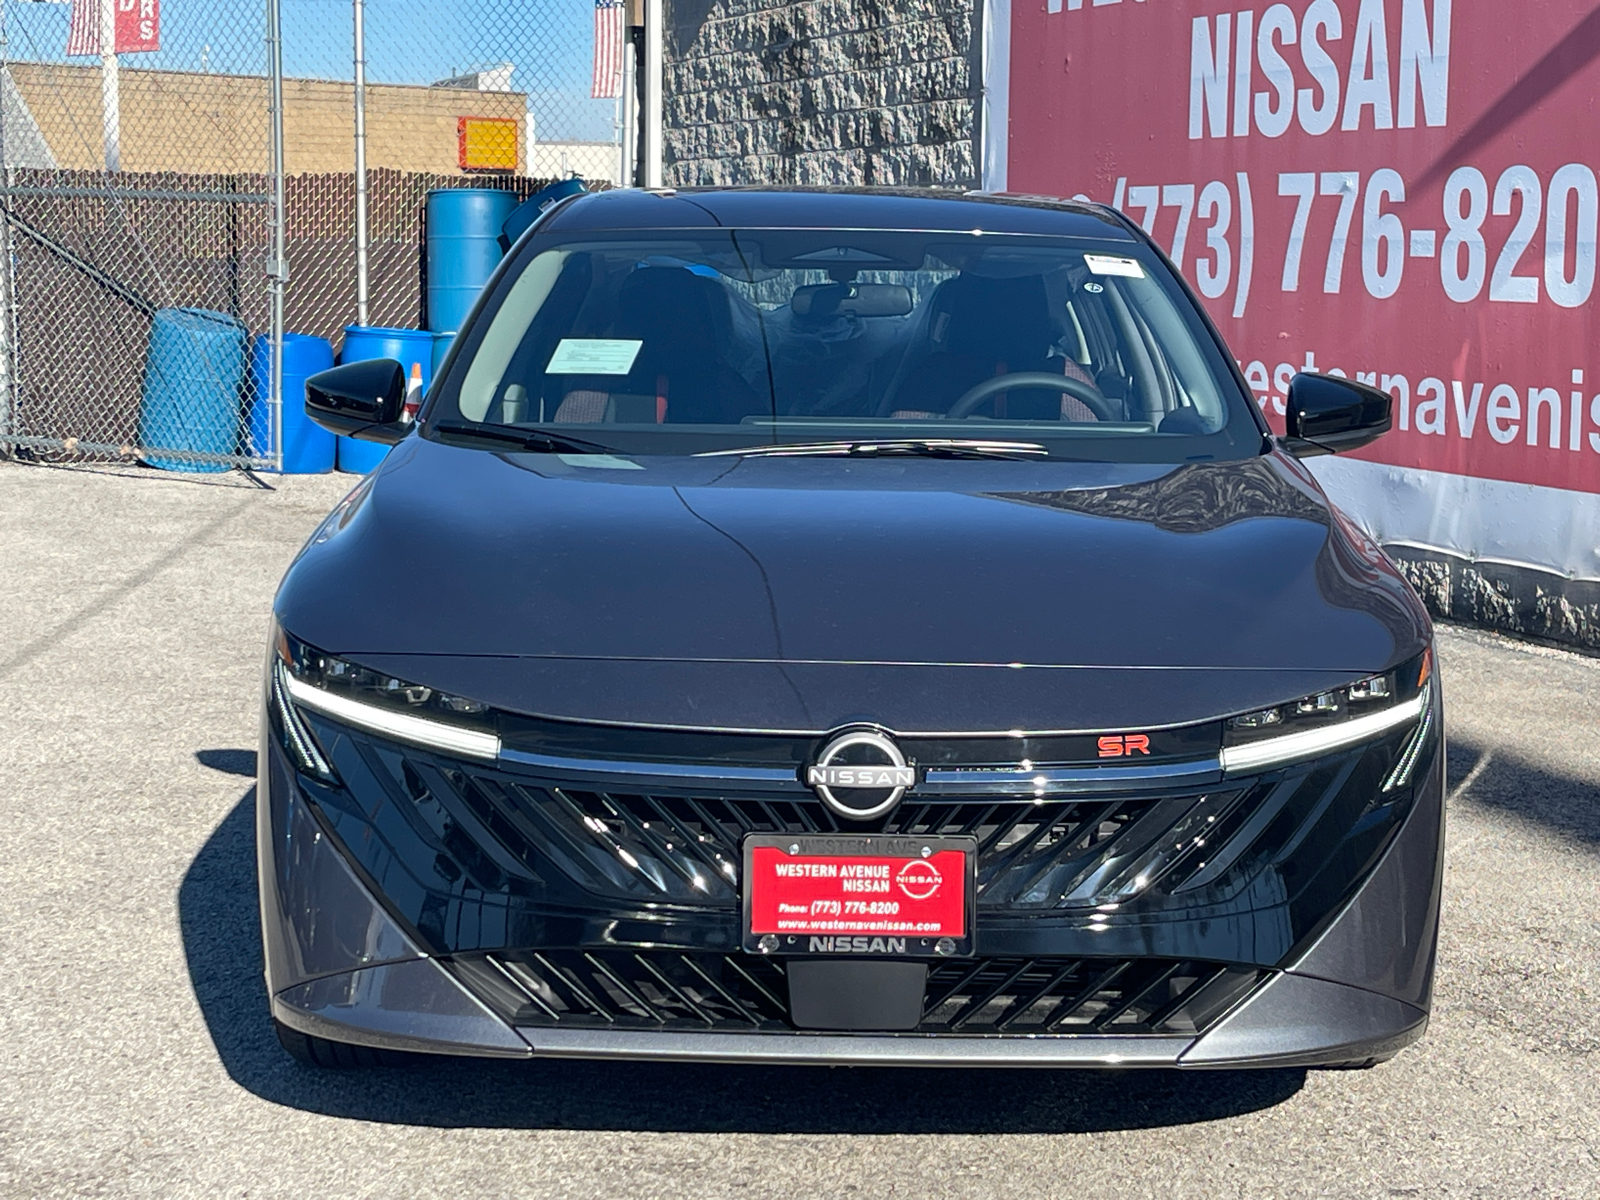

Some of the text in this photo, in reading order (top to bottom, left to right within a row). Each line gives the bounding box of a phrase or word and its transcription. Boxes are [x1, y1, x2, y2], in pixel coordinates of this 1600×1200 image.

[1189, 0, 1451, 139] NISSAN
[1098, 734, 1150, 757] SR
[810, 768, 912, 784] NISSAN
[800, 838, 918, 854] WESTERN AVE
[775, 864, 890, 878] WESTERN AVENUE
[896, 874, 943, 884] NISSAN
[843, 879, 890, 893] NISSAN
[778, 900, 900, 917] Phone: (773) 776-8200
[778, 919, 941, 932] www.westernavenissan.com
[809, 936, 906, 952] NISSAN
